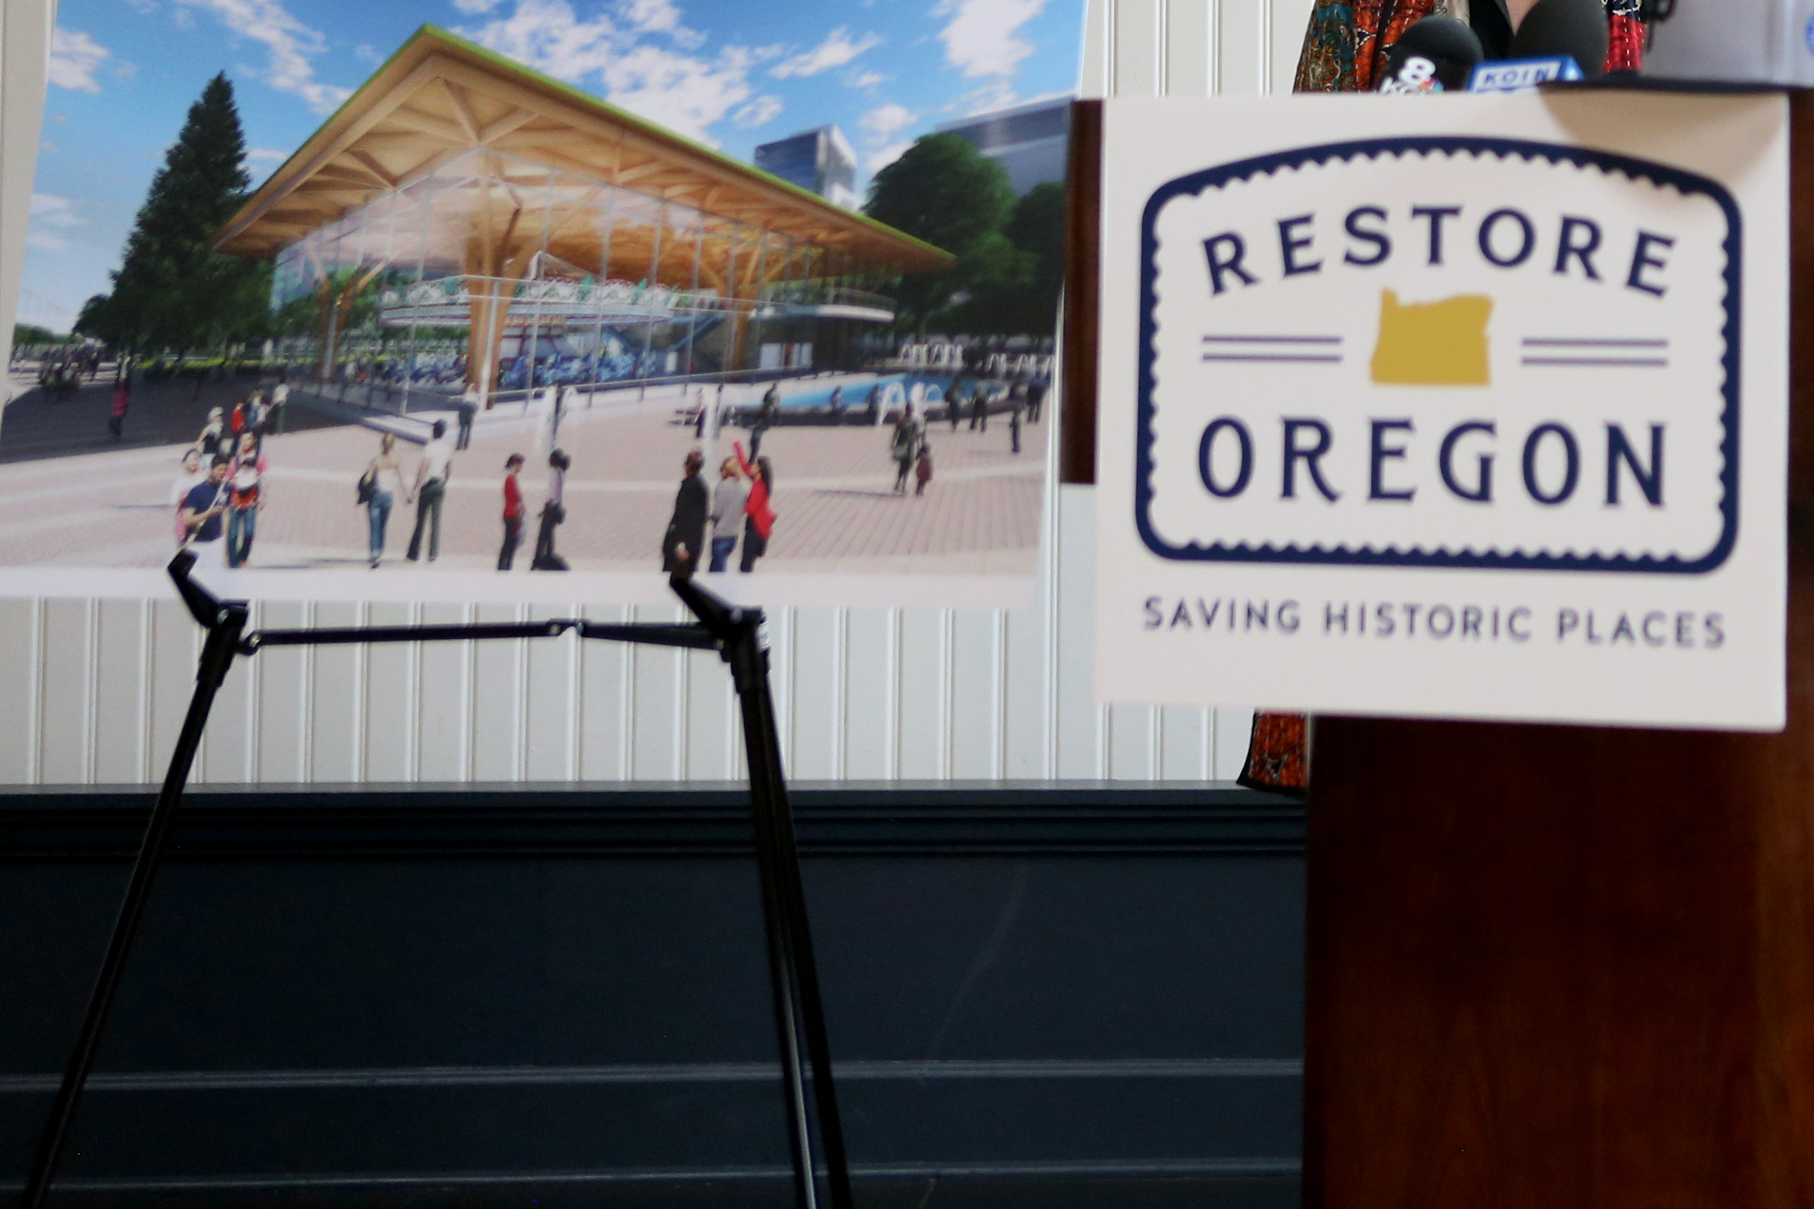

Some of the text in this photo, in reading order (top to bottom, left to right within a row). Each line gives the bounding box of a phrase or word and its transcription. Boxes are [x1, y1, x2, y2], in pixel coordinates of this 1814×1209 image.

[1399, 56, 1436, 86] 8
[1484, 68, 1551, 85] KOIN
[1201, 204, 1677, 298] RESTORE
[1197, 415, 1667, 510] OREGON
[1143, 596, 1725, 650] SAVING HISTORIC PLACES
